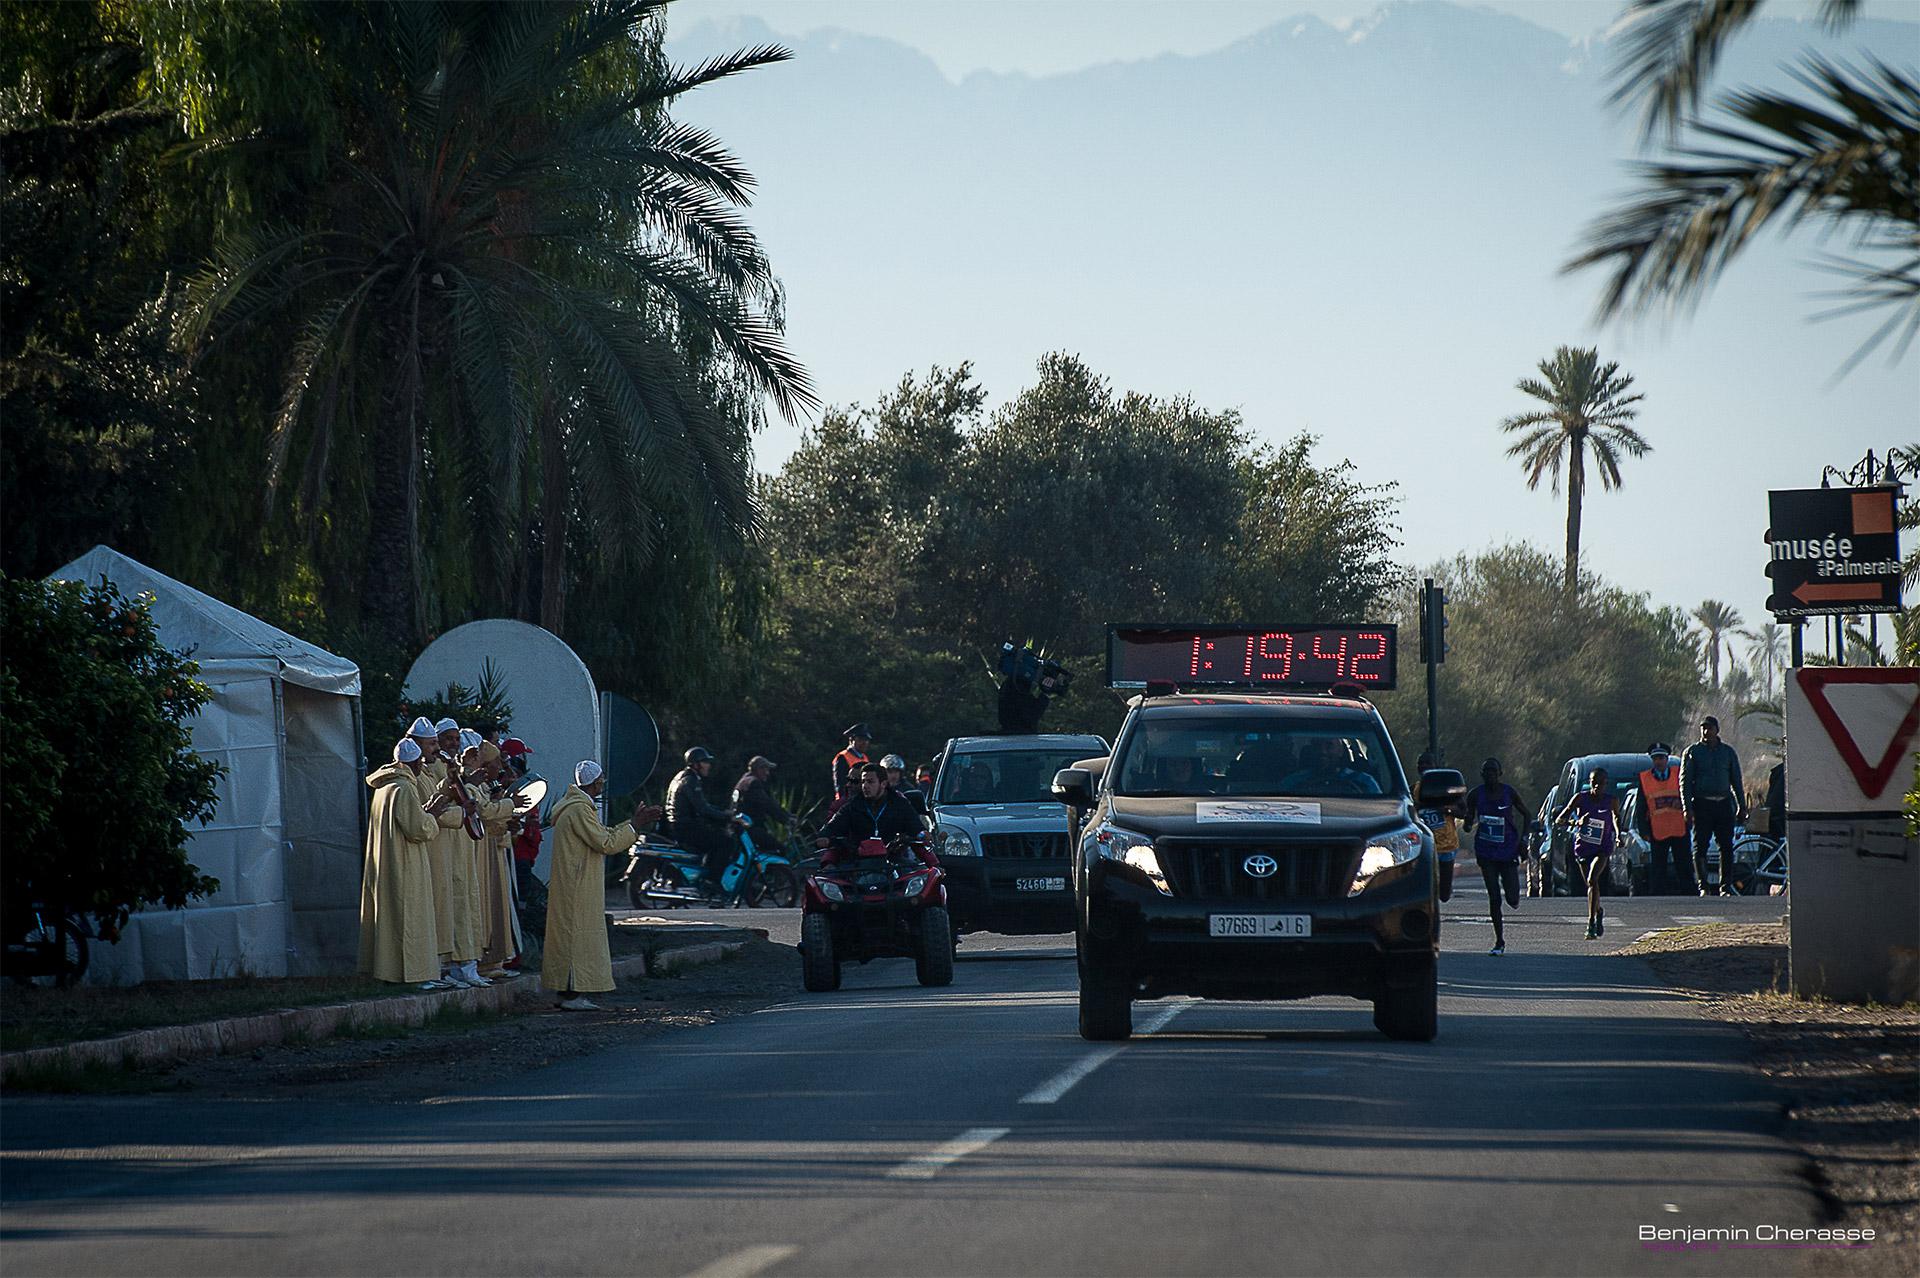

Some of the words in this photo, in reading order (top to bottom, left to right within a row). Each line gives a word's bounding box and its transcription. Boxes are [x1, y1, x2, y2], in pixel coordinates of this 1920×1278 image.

[1771, 532, 1853, 561] musée
[1825, 558, 1901, 577] Palmeraie
[1586, 827, 1593, 837] 3
[1217, 917, 1257, 934] 37669
[1295, 917, 1304, 934] 6
